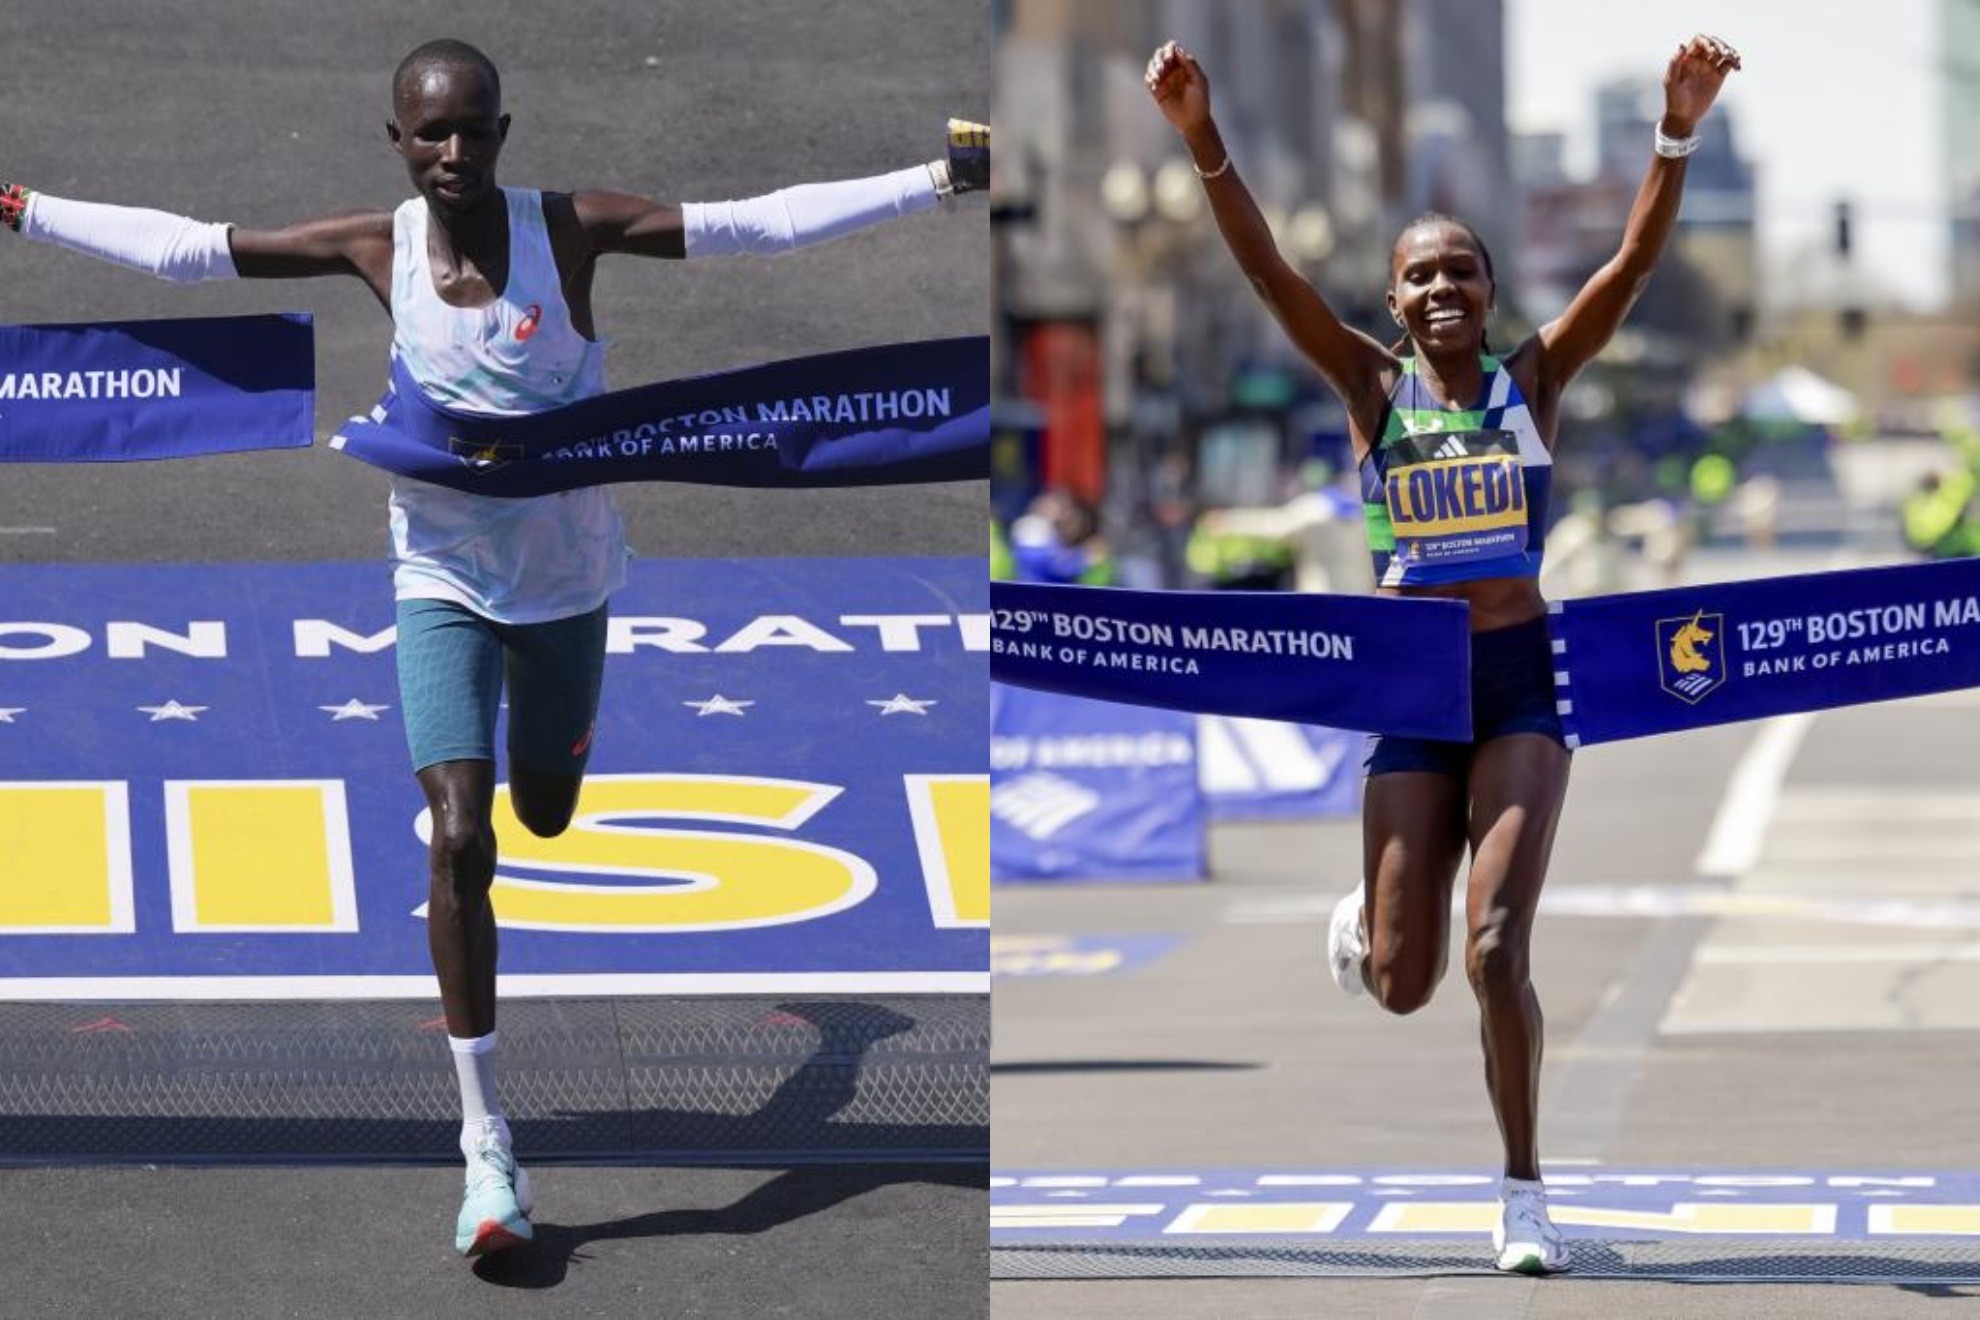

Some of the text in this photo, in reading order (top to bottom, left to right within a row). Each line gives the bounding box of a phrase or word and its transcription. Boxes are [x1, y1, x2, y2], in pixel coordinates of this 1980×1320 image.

[756, 387, 951, 423] MARATHON
[620, 438, 652, 456] OF
[660, 432, 779, 454] AMERICA
[1388, 462, 1523, 523] LOKEDI
[1052, 612, 1175, 648] BOSTON
[1180, 626, 1354, 661] MARATHON
[1737, 596, 1980, 651] 129TH BOSTON MA
[992, 637, 1200, 675] BANK OF AMERICA
[1743, 637, 1950, 677] BANK OF AMERICA
